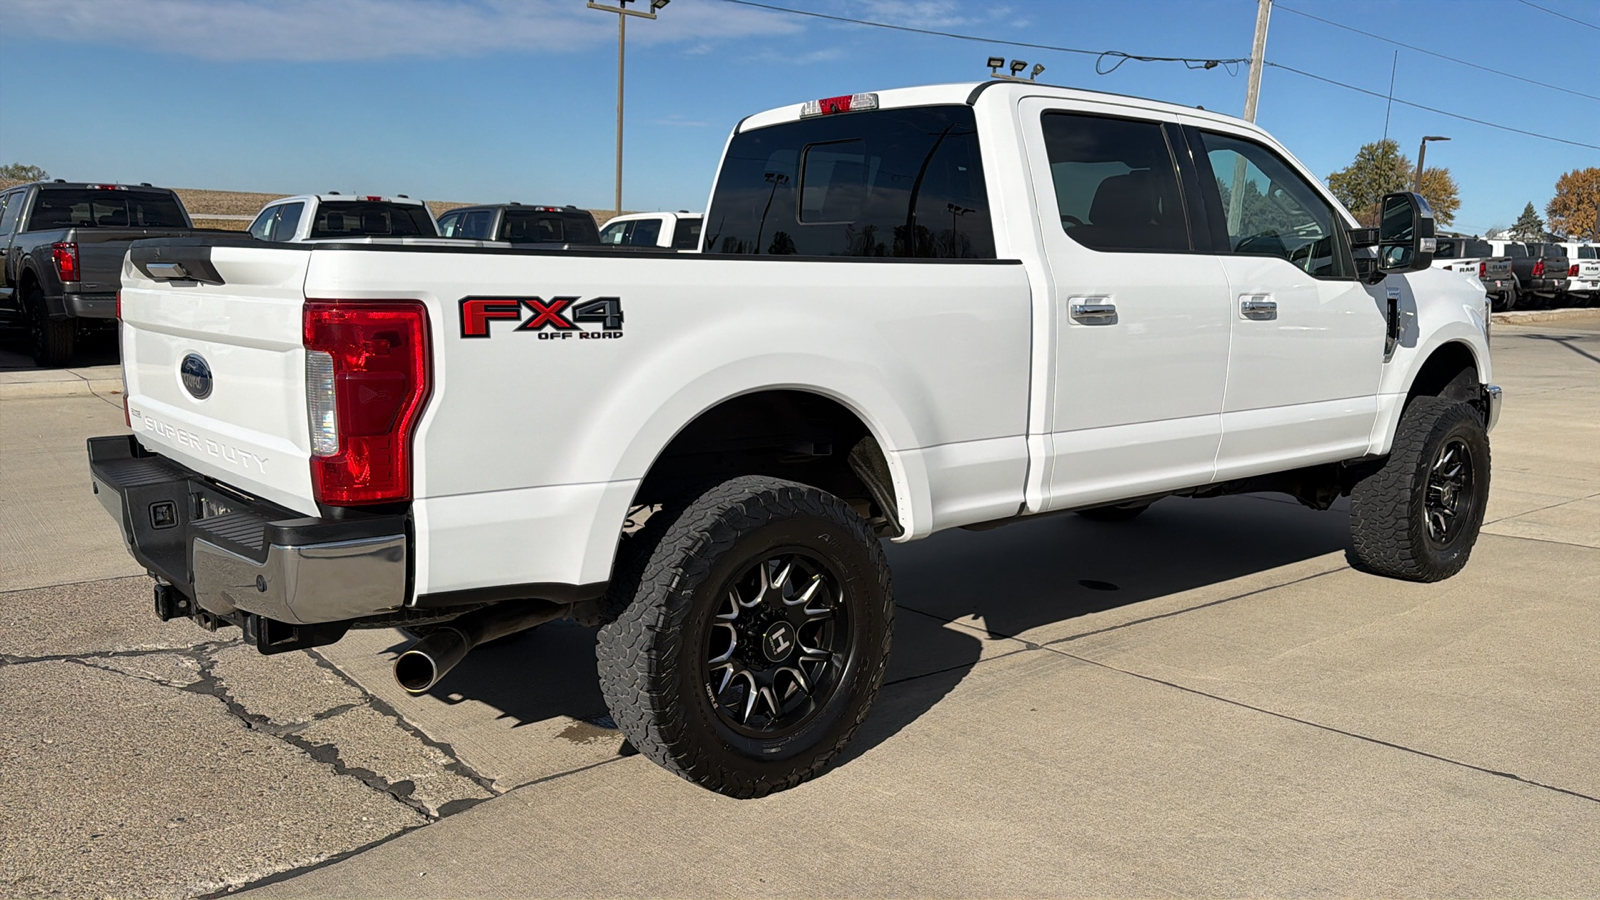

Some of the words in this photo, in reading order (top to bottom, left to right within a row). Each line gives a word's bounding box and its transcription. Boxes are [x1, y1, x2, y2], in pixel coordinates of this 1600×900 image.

[458, 295, 624, 339] FX4
[538, 332, 573, 340] OFF
[579, 332, 624, 340] ROAD
[144, 415, 203, 451] SUPER
[206, 438, 269, 474] DUTY
